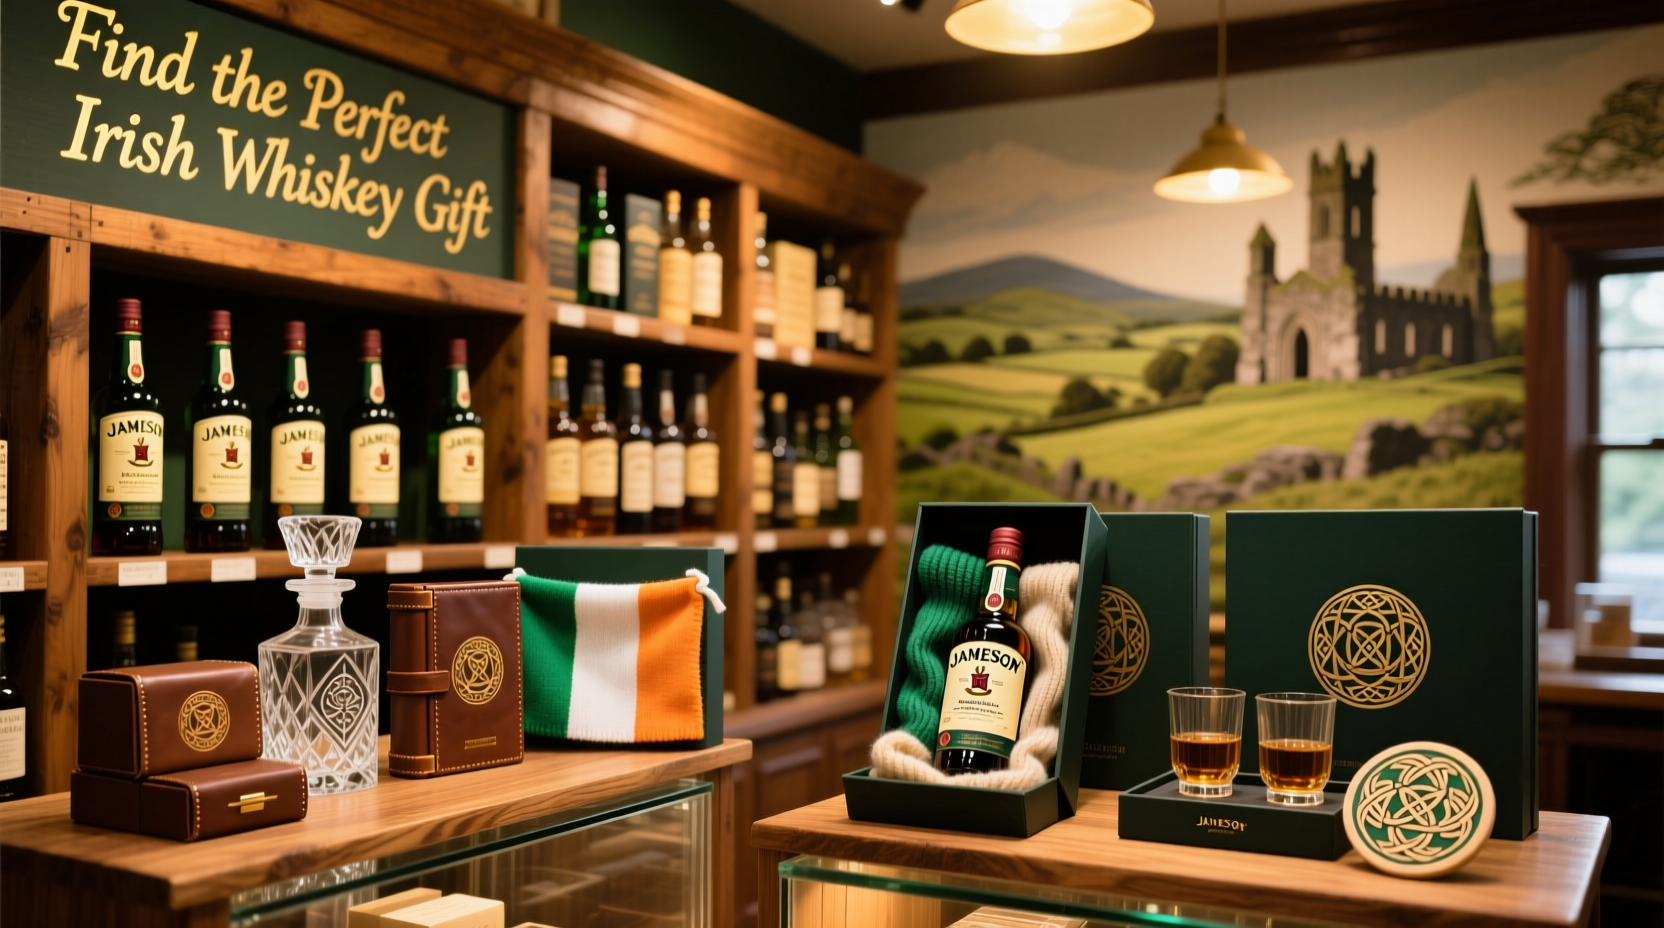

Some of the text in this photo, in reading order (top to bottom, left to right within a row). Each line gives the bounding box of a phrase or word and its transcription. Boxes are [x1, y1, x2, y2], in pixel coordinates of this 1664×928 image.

[54, 0, 449, 163] Find the Perfect
[60, 94, 493, 254] Irish Whiskey Gift
[950, 647, 1022, 675] JAMESON
